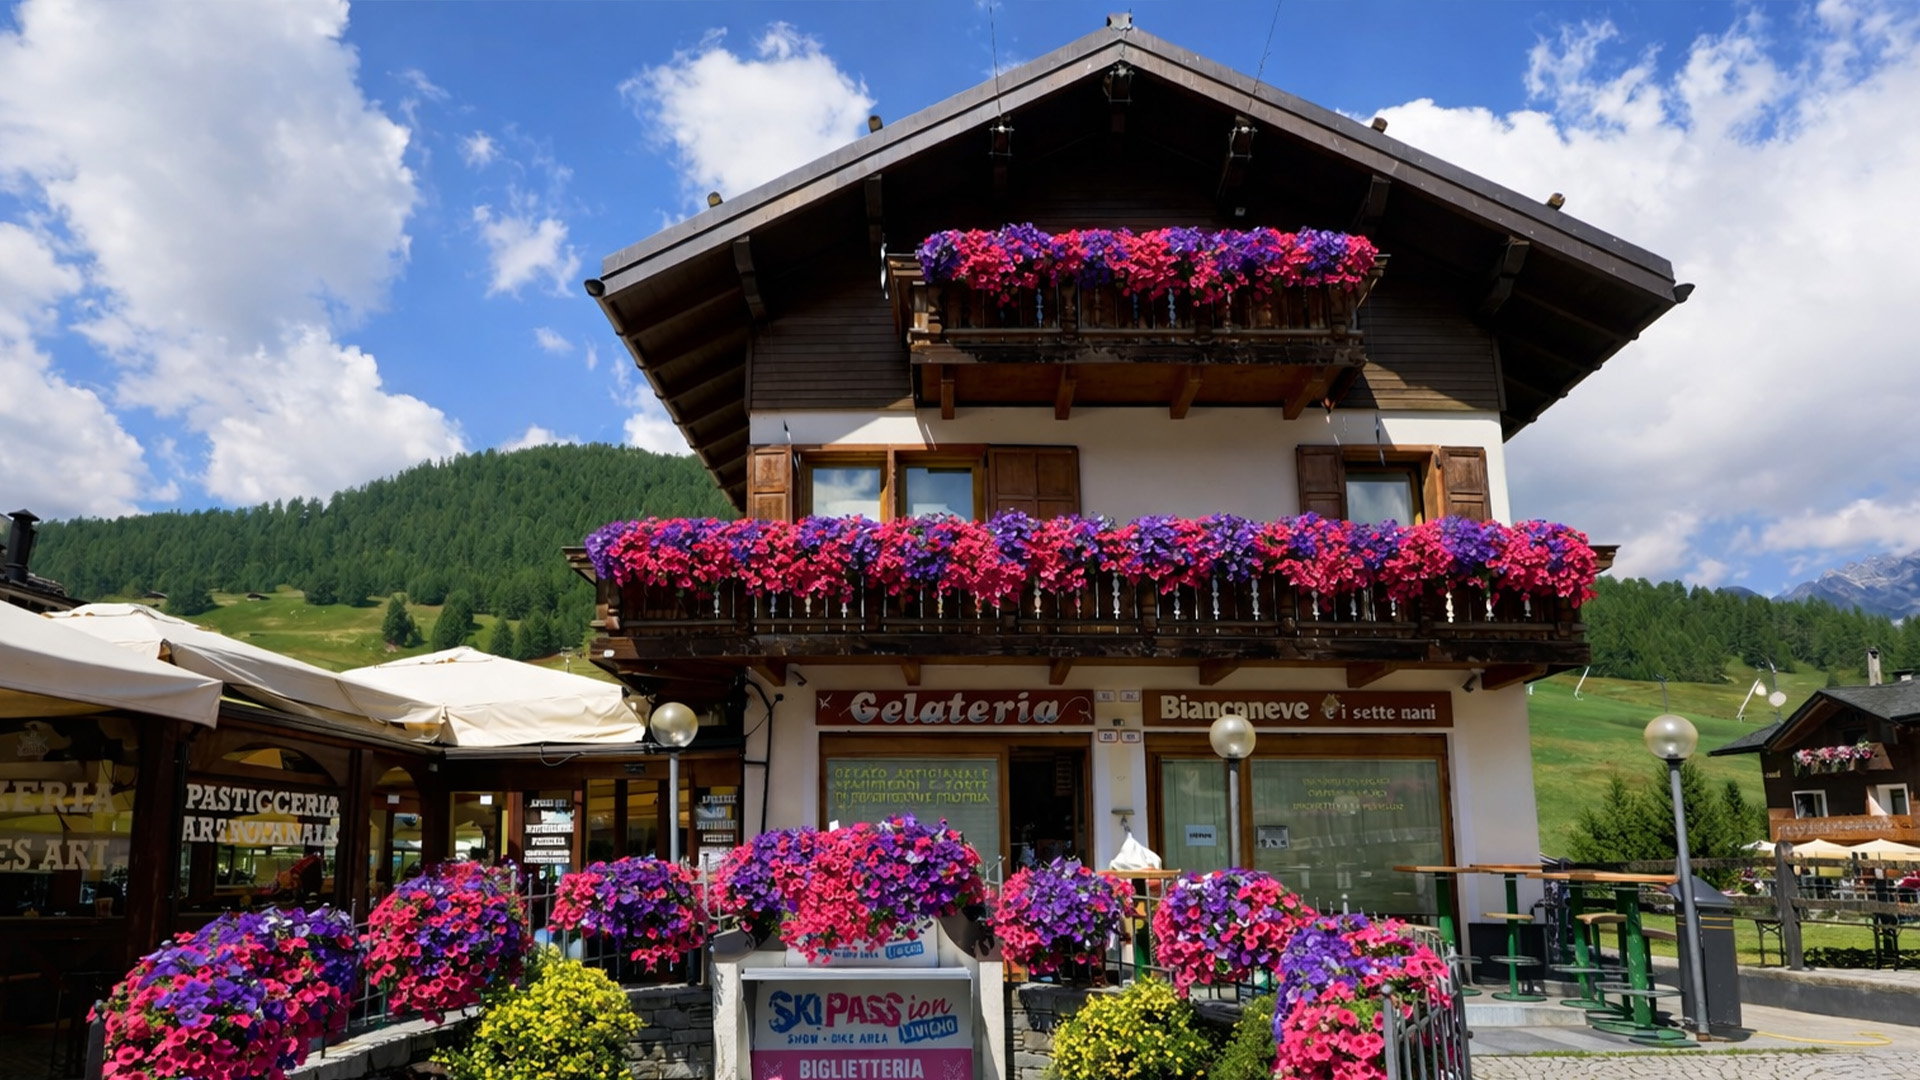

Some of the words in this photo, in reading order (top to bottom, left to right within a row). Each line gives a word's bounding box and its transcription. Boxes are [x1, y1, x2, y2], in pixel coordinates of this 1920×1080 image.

[849, 691, 1060, 724] Gelateria
[1160, 695, 1310, 719] Biancaneve
[1352, 705, 1396, 720] sette
[1401, 704, 1437, 720] nani
[185, 783, 340, 818] PASTICCERIA
[799, 1058, 925, 1080] BIGLIETTERIA
